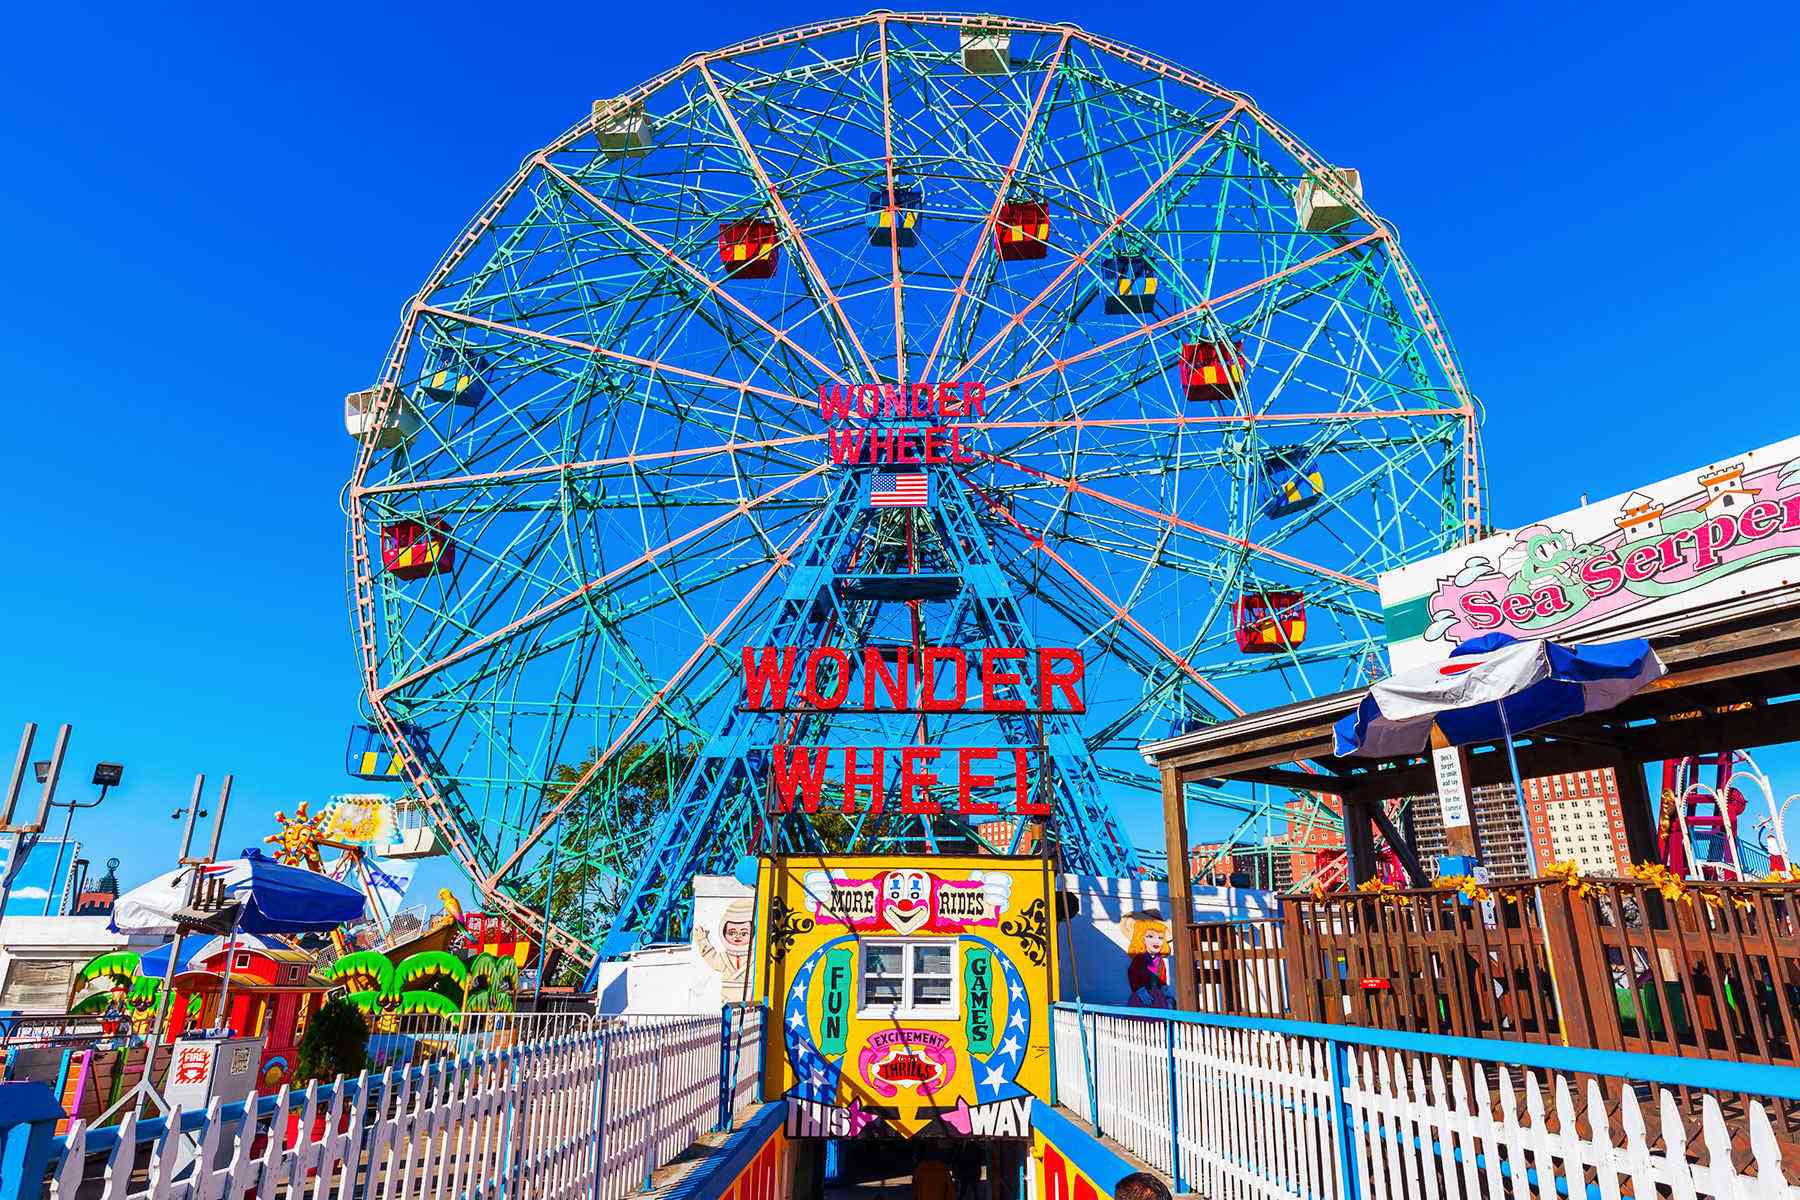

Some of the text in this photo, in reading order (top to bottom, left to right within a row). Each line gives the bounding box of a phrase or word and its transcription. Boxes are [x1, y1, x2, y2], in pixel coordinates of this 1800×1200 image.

[819, 382, 986, 420] WONDER
[829, 426, 975, 464] WHEEL
[1459, 583, 1570, 631] Sea
[741, 646, 1085, 712] WONDER
[772, 744, 1051, 815] WHEEL
[830, 889, 985, 916] MORE RIDES
[826, 965, 845, 1040] FUN
[970, 957, 989, 1043] GAMES
[185, 1053, 205, 1062] FIRE
[873, 1030, 945, 1048] EXCITEMENT
[881, 1060, 934, 1079] THRILLS
[786, 1096, 1035, 1137] THIS WAY
